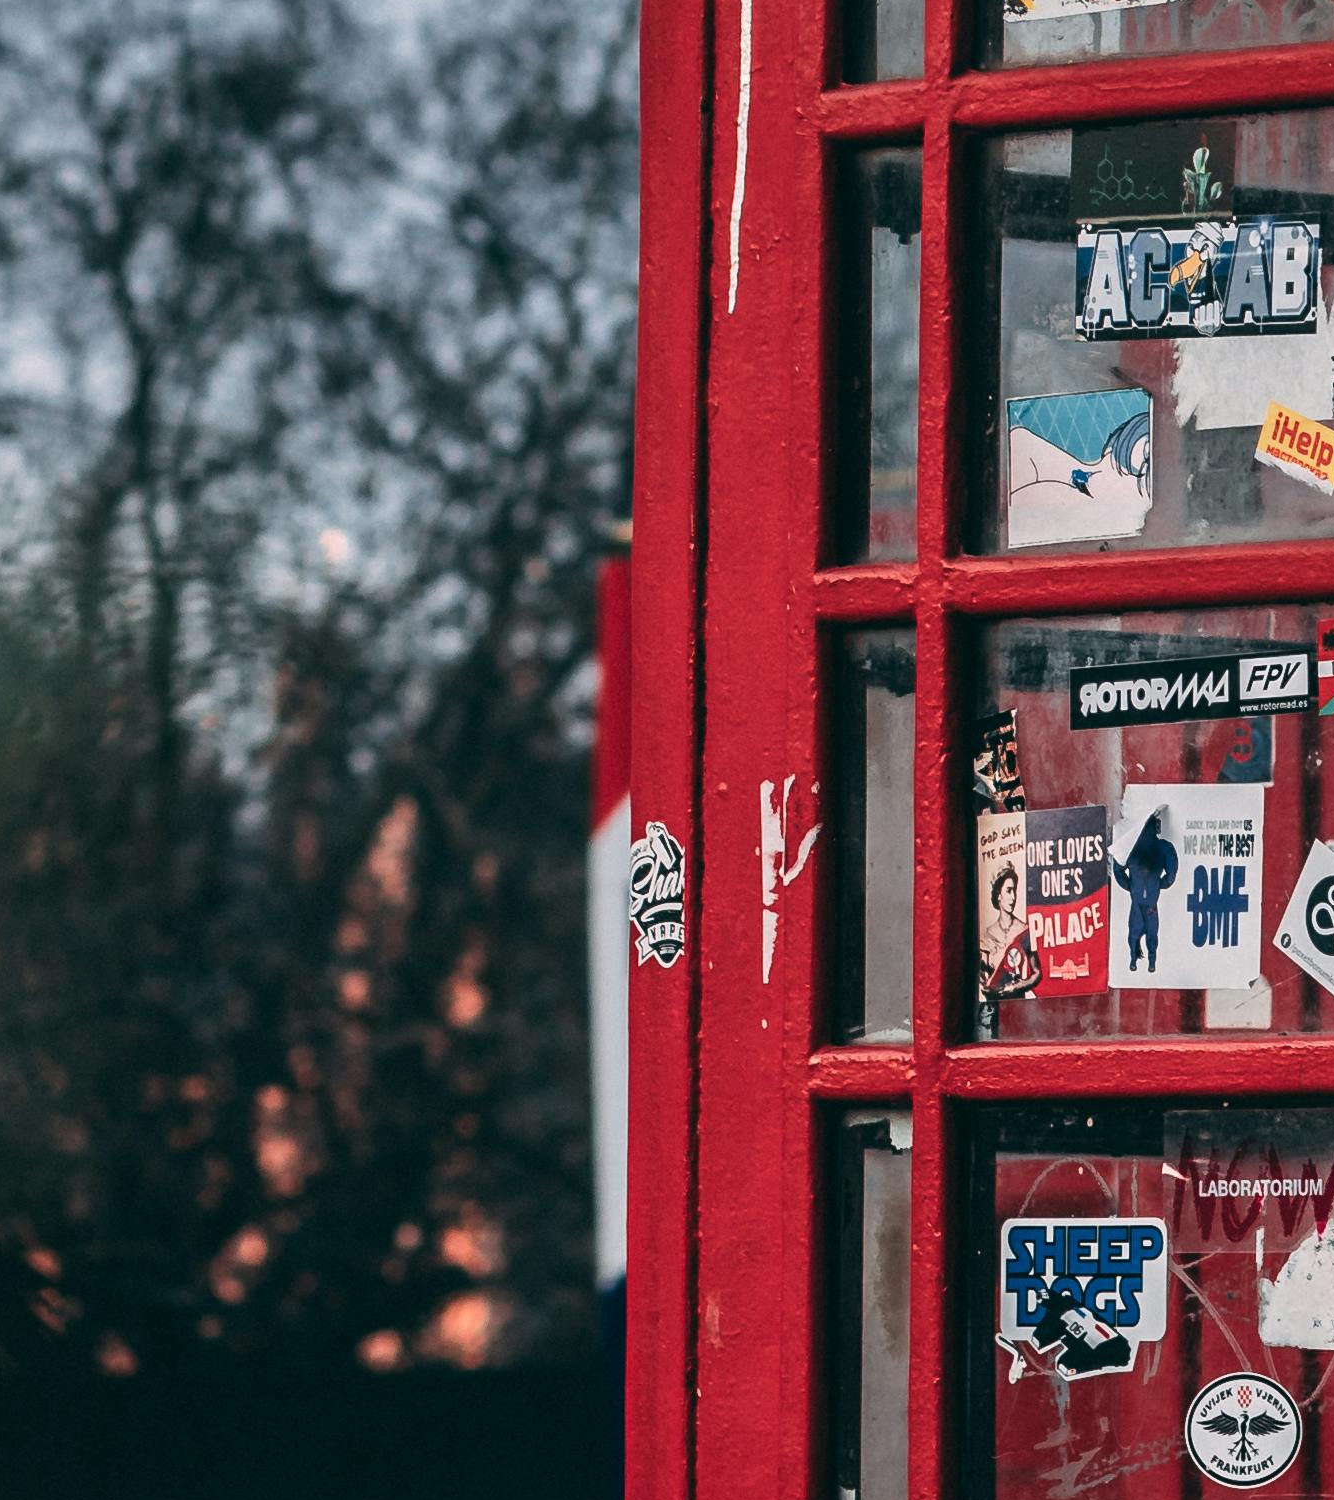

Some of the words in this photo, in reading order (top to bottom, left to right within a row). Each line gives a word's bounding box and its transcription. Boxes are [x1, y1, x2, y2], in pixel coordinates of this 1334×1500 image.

[1271, 411, 1334, 468] iHelp
[1245, 661, 1302, 693] FPV
[1239, 699, 1309, 713] www.rotormad.es
[980, 832, 998, 847] GOD
[1001, 823, 1022, 840] SAVE
[999, 842, 1025, 858] QUEEN
[1027, 839, 1053, 867] ONE
[1057, 834, 1104, 864] LOVES
[1041, 868, 1084, 898] ONE'S
[1187, 865, 1249, 948] BMF
[649, 923, 685, 941] VAPE
[1028, 902, 1104, 952] PALACE
[1198, 1178, 1323, 1198] LABORATORIUM
[1006, 1224, 1165, 1275] SHEEP
[1006, 1276, 1144, 1328] DOGS
[1200, 1387, 1234, 1418] UVIJEK
[1255, 1387, 1289, 1419] VJERNI
[1210, 1454, 1275, 1476] FRANKFURT
